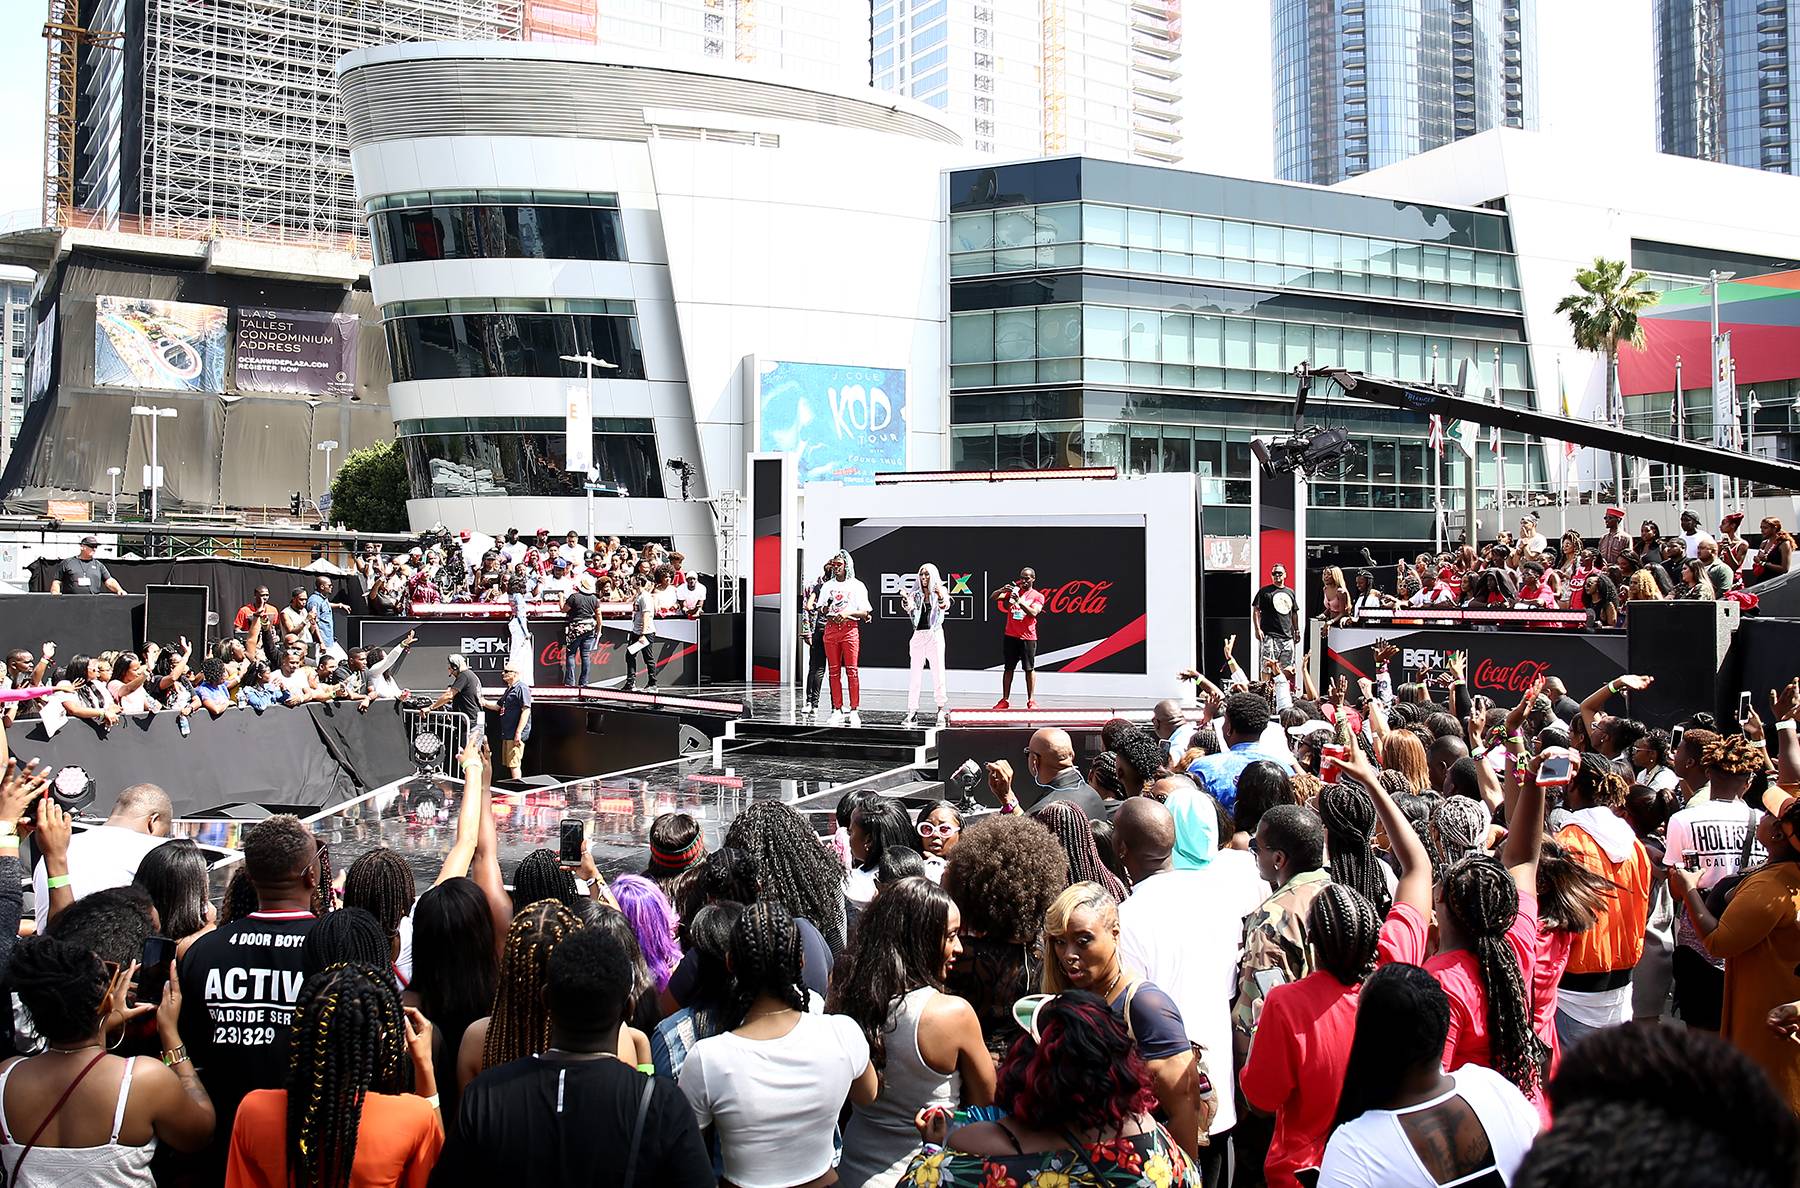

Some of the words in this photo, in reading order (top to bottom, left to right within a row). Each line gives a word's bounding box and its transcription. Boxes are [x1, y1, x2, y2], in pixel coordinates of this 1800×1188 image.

[240, 319, 294, 331] TALLEST
[239, 330, 334, 345] CONDOMINIUM
[238, 340, 301, 353] ADDRESS
[238, 356, 329, 369] OCEANWIDEPLAZA.COM
[238, 363, 278, 372] REGISTER
[280, 365, 300, 373] NOW
[846, 371, 881, 382] COLE
[827, 384, 892, 440] KOD
[857, 433, 899, 448] TOUR
[848, 454, 876, 464] YOUNG
[461, 637, 496, 653] BET
[1402, 649, 1435, 667] BET
[1697, 824, 1767, 851] HOLLISE
[229, 933, 238, 945] 4
[239, 932, 272, 946] DOOR
[208, 1009, 265, 1023] RADSIDE
[270, 1010, 295, 1025] SER
